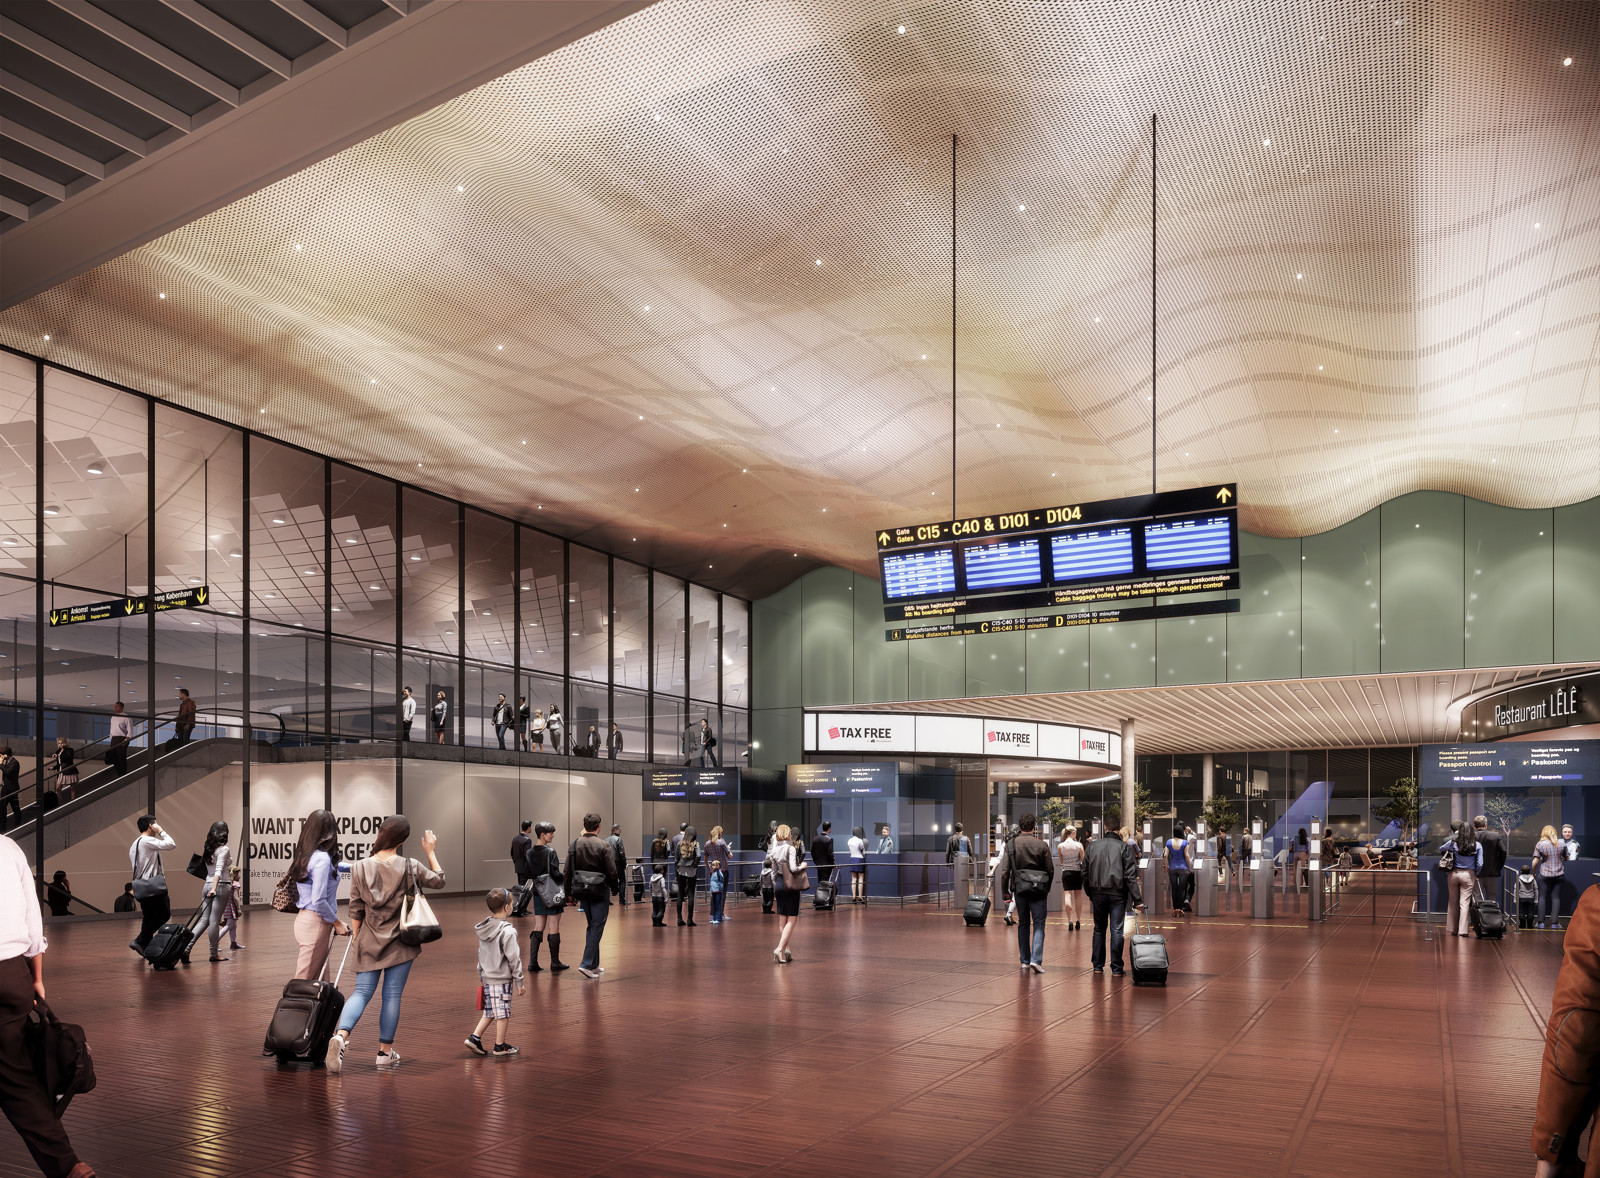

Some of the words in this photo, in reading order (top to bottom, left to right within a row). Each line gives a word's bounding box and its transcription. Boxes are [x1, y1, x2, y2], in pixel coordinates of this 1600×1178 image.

[917, 525, 940, 540] C15
[952, 520, 980, 535] C40
[984, 518, 995, 531] &
[1000, 513, 1029, 530] D101
[1046, 506, 1082, 524] D104
[166, 591, 192, 600] København
[71, 614, 86, 622] Arrivals
[1056, 616, 1063, 626] D
[981, 623, 988, 632] C
[1495, 700, 1546, 726] Restaurant
[1551, 686, 1576, 717] LÊLÊ
[840, 728, 862, 738] TAX
[864, 728, 891, 738] FREE
[996, 732, 1011, 742] TAX
[1012, 733, 1030, 743] FREE
[1086, 740, 1095, 750] TAX
[1096, 742, 1105, 751] FREE
[252, 818, 294, 834] WANT
[336, 816, 389, 834] XPLOR
[1372, 838, 1398, 848] SAS
